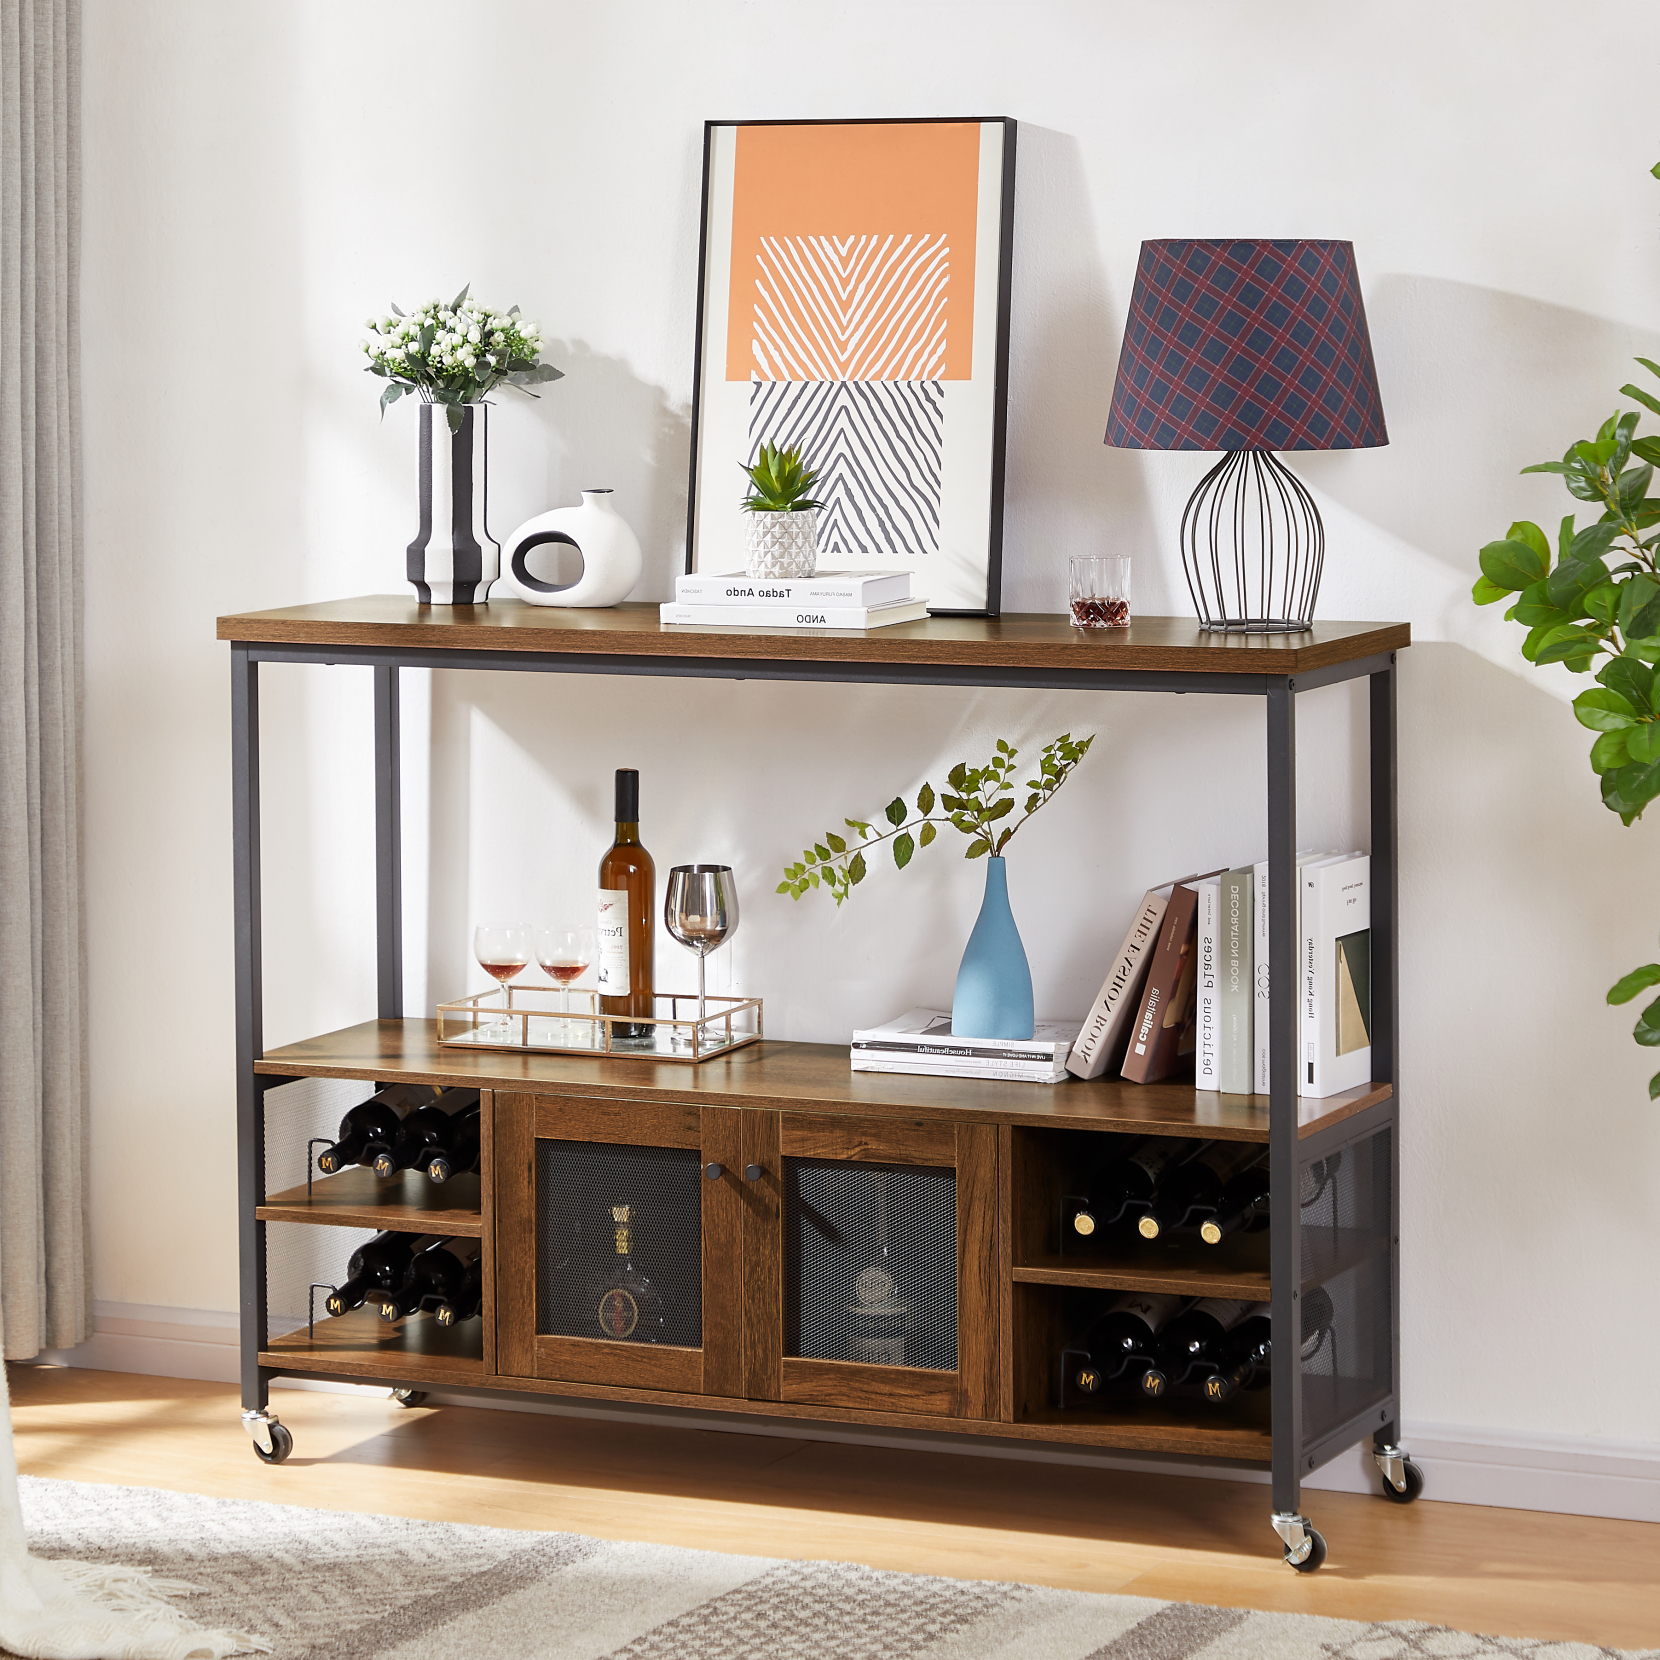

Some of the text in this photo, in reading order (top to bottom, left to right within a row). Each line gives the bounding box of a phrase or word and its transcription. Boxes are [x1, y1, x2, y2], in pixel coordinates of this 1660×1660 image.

[321, 1157, 334, 1171] M
[376, 1159, 389, 1176] M
[430, 1165, 443, 1180] M
[330, 1298, 341, 1314] M
[381, 1303, 393, 1320] M
[438, 1308, 451, 1326] M
[1080, 1372, 1094, 1391] M
[1146, 1375, 1160, 1395] M
[1207, 1382, 1222, 1399] M
